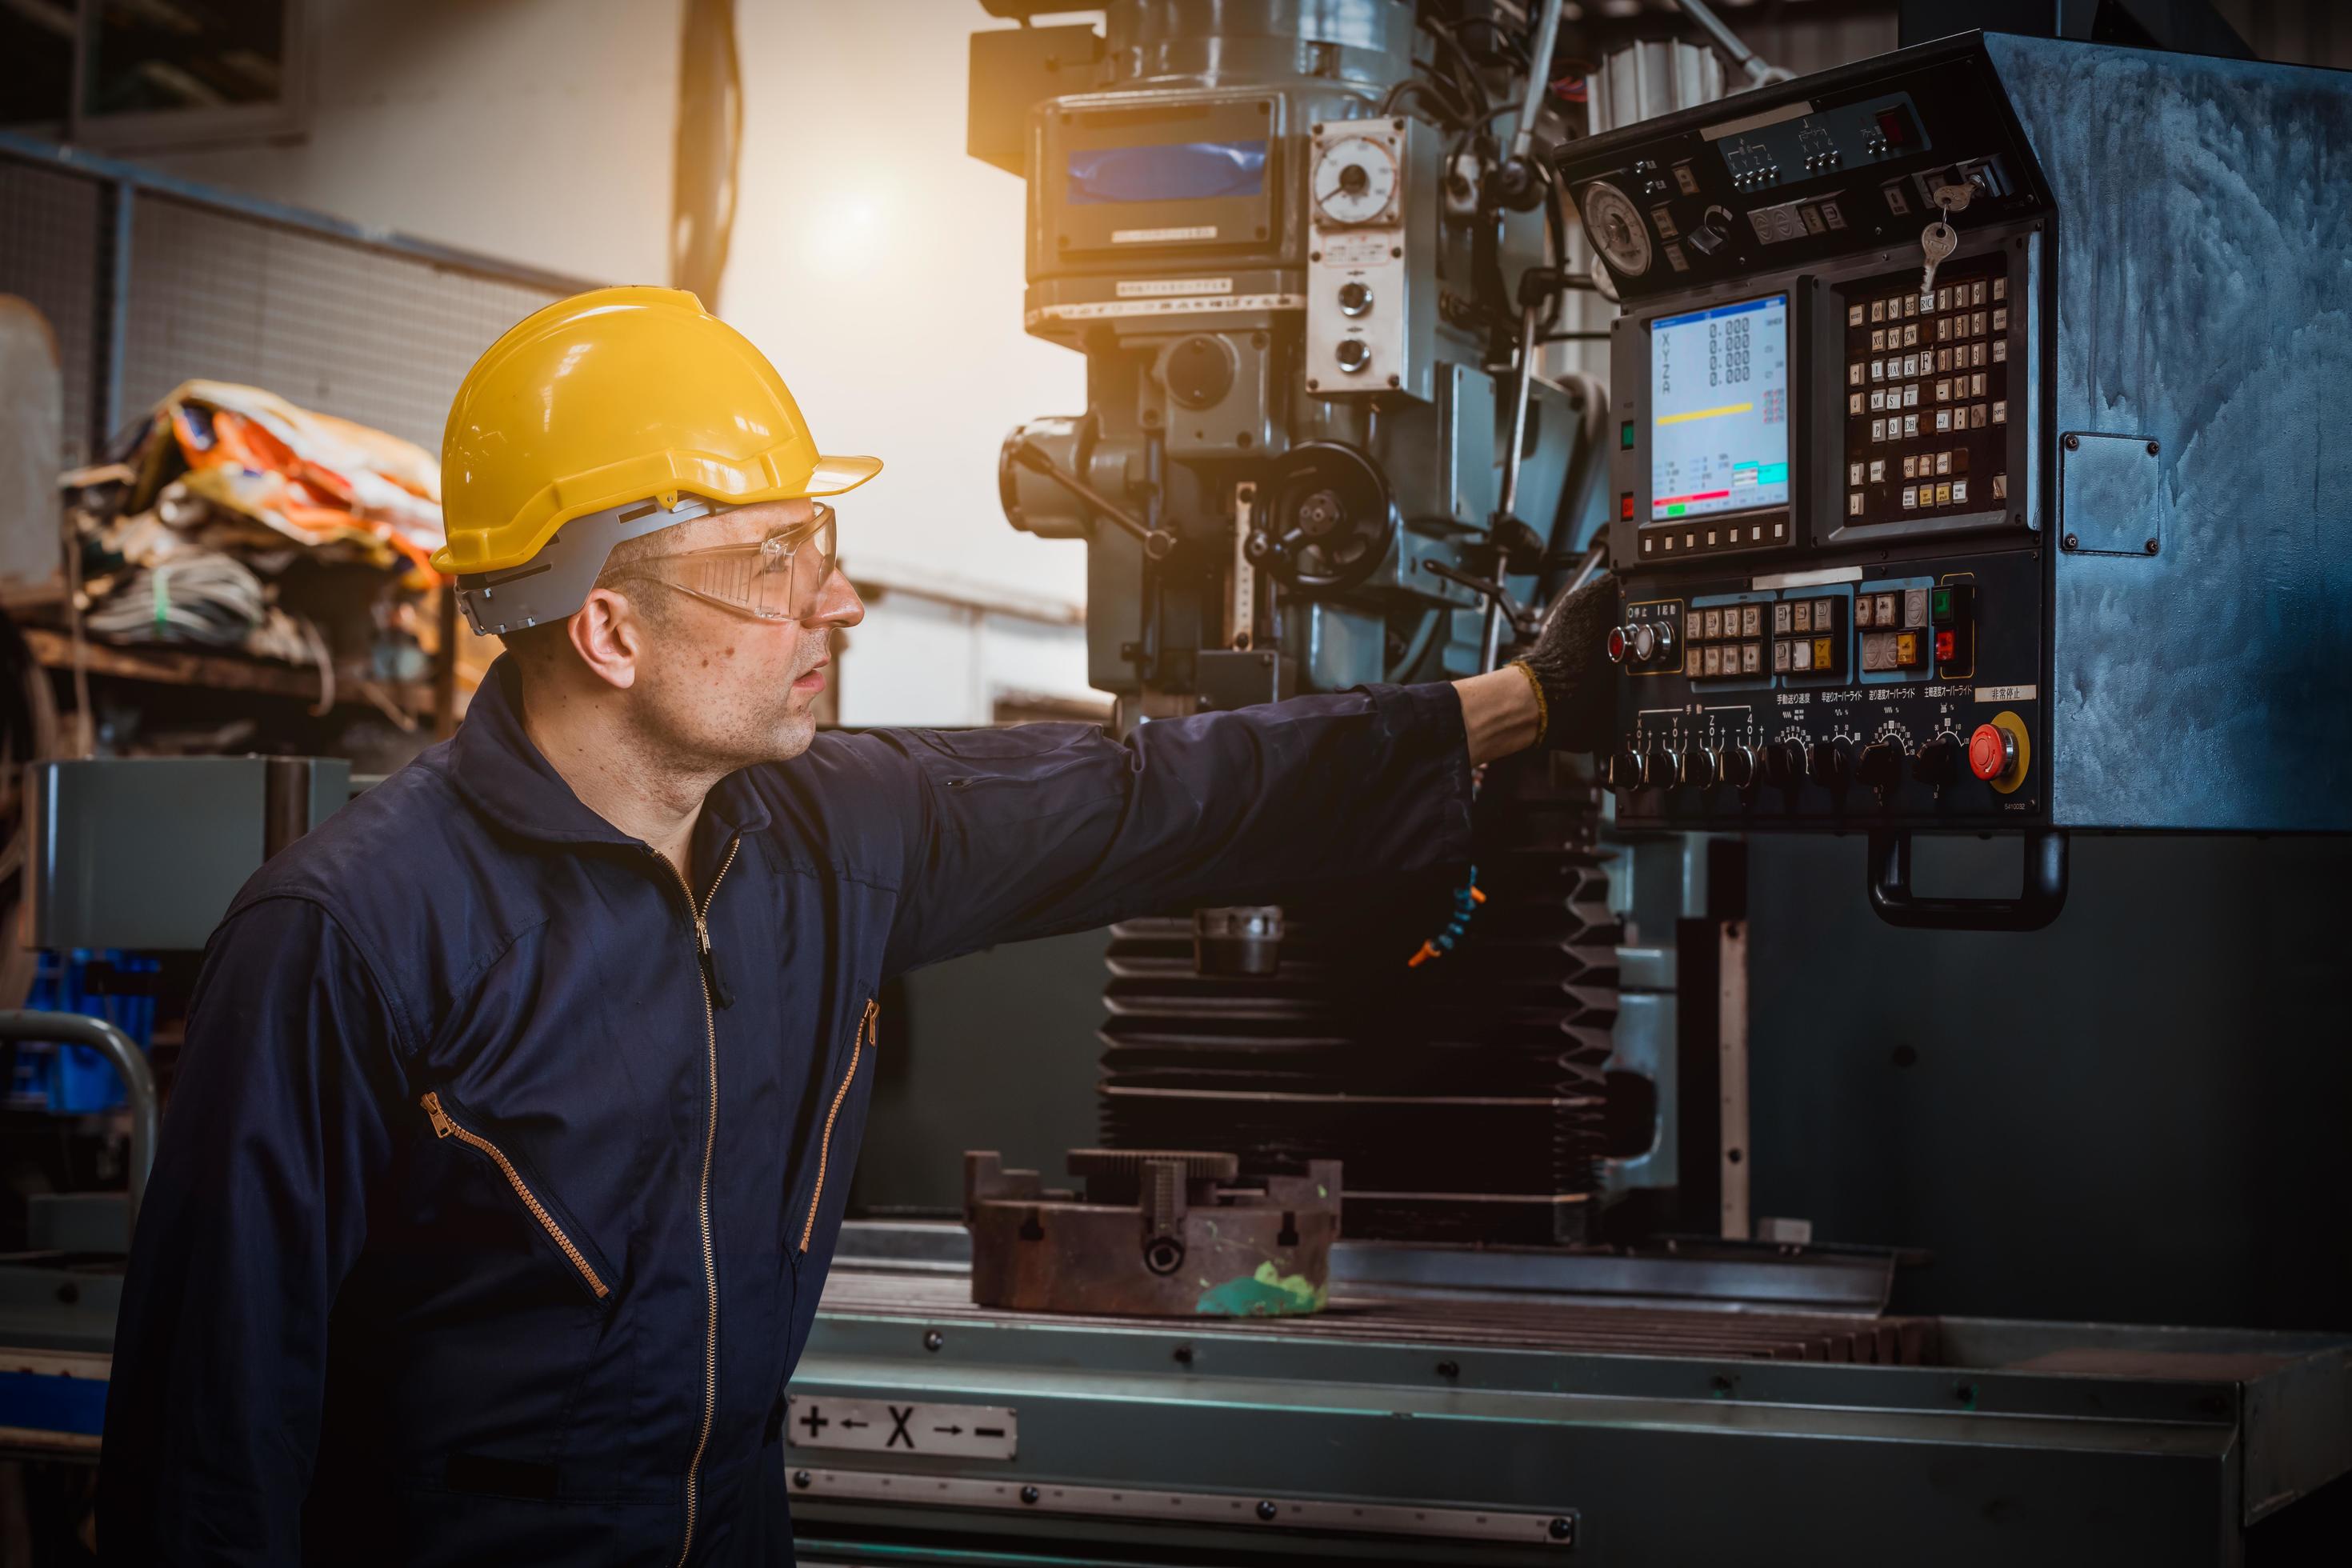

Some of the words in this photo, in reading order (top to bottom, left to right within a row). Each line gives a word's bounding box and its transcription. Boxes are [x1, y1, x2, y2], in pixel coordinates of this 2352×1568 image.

[1905, 302, 1914, 311] GE
[1662, 333, 1670, 346] X
[1874, 335, 1882, 346] XU
[1890, 334, 1898, 344] YV
[1905, 330, 1915, 342] ZW
[1662, 349, 1670, 362] Y
[1922, 352, 1930, 370] F
[1662, 364, 1670, 379] Z
[1907, 363, 1912, 373] K
[1874, 397, 1879, 406] M
[1890, 397, 1894, 406] S
[1907, 394, 1912, 403] T
[1890, 422, 1895, 432] Q
[1906, 420, 1914, 430] DH
[1875, 426, 1880, 435] P
[1992, 687, 2020, 701] 非常停止
[1672, 717, 1678, 727] Y
[1709, 715, 1715, 726] Z
[1747, 714, 1753, 724] 4
[886, 1405, 915, 1449] X
